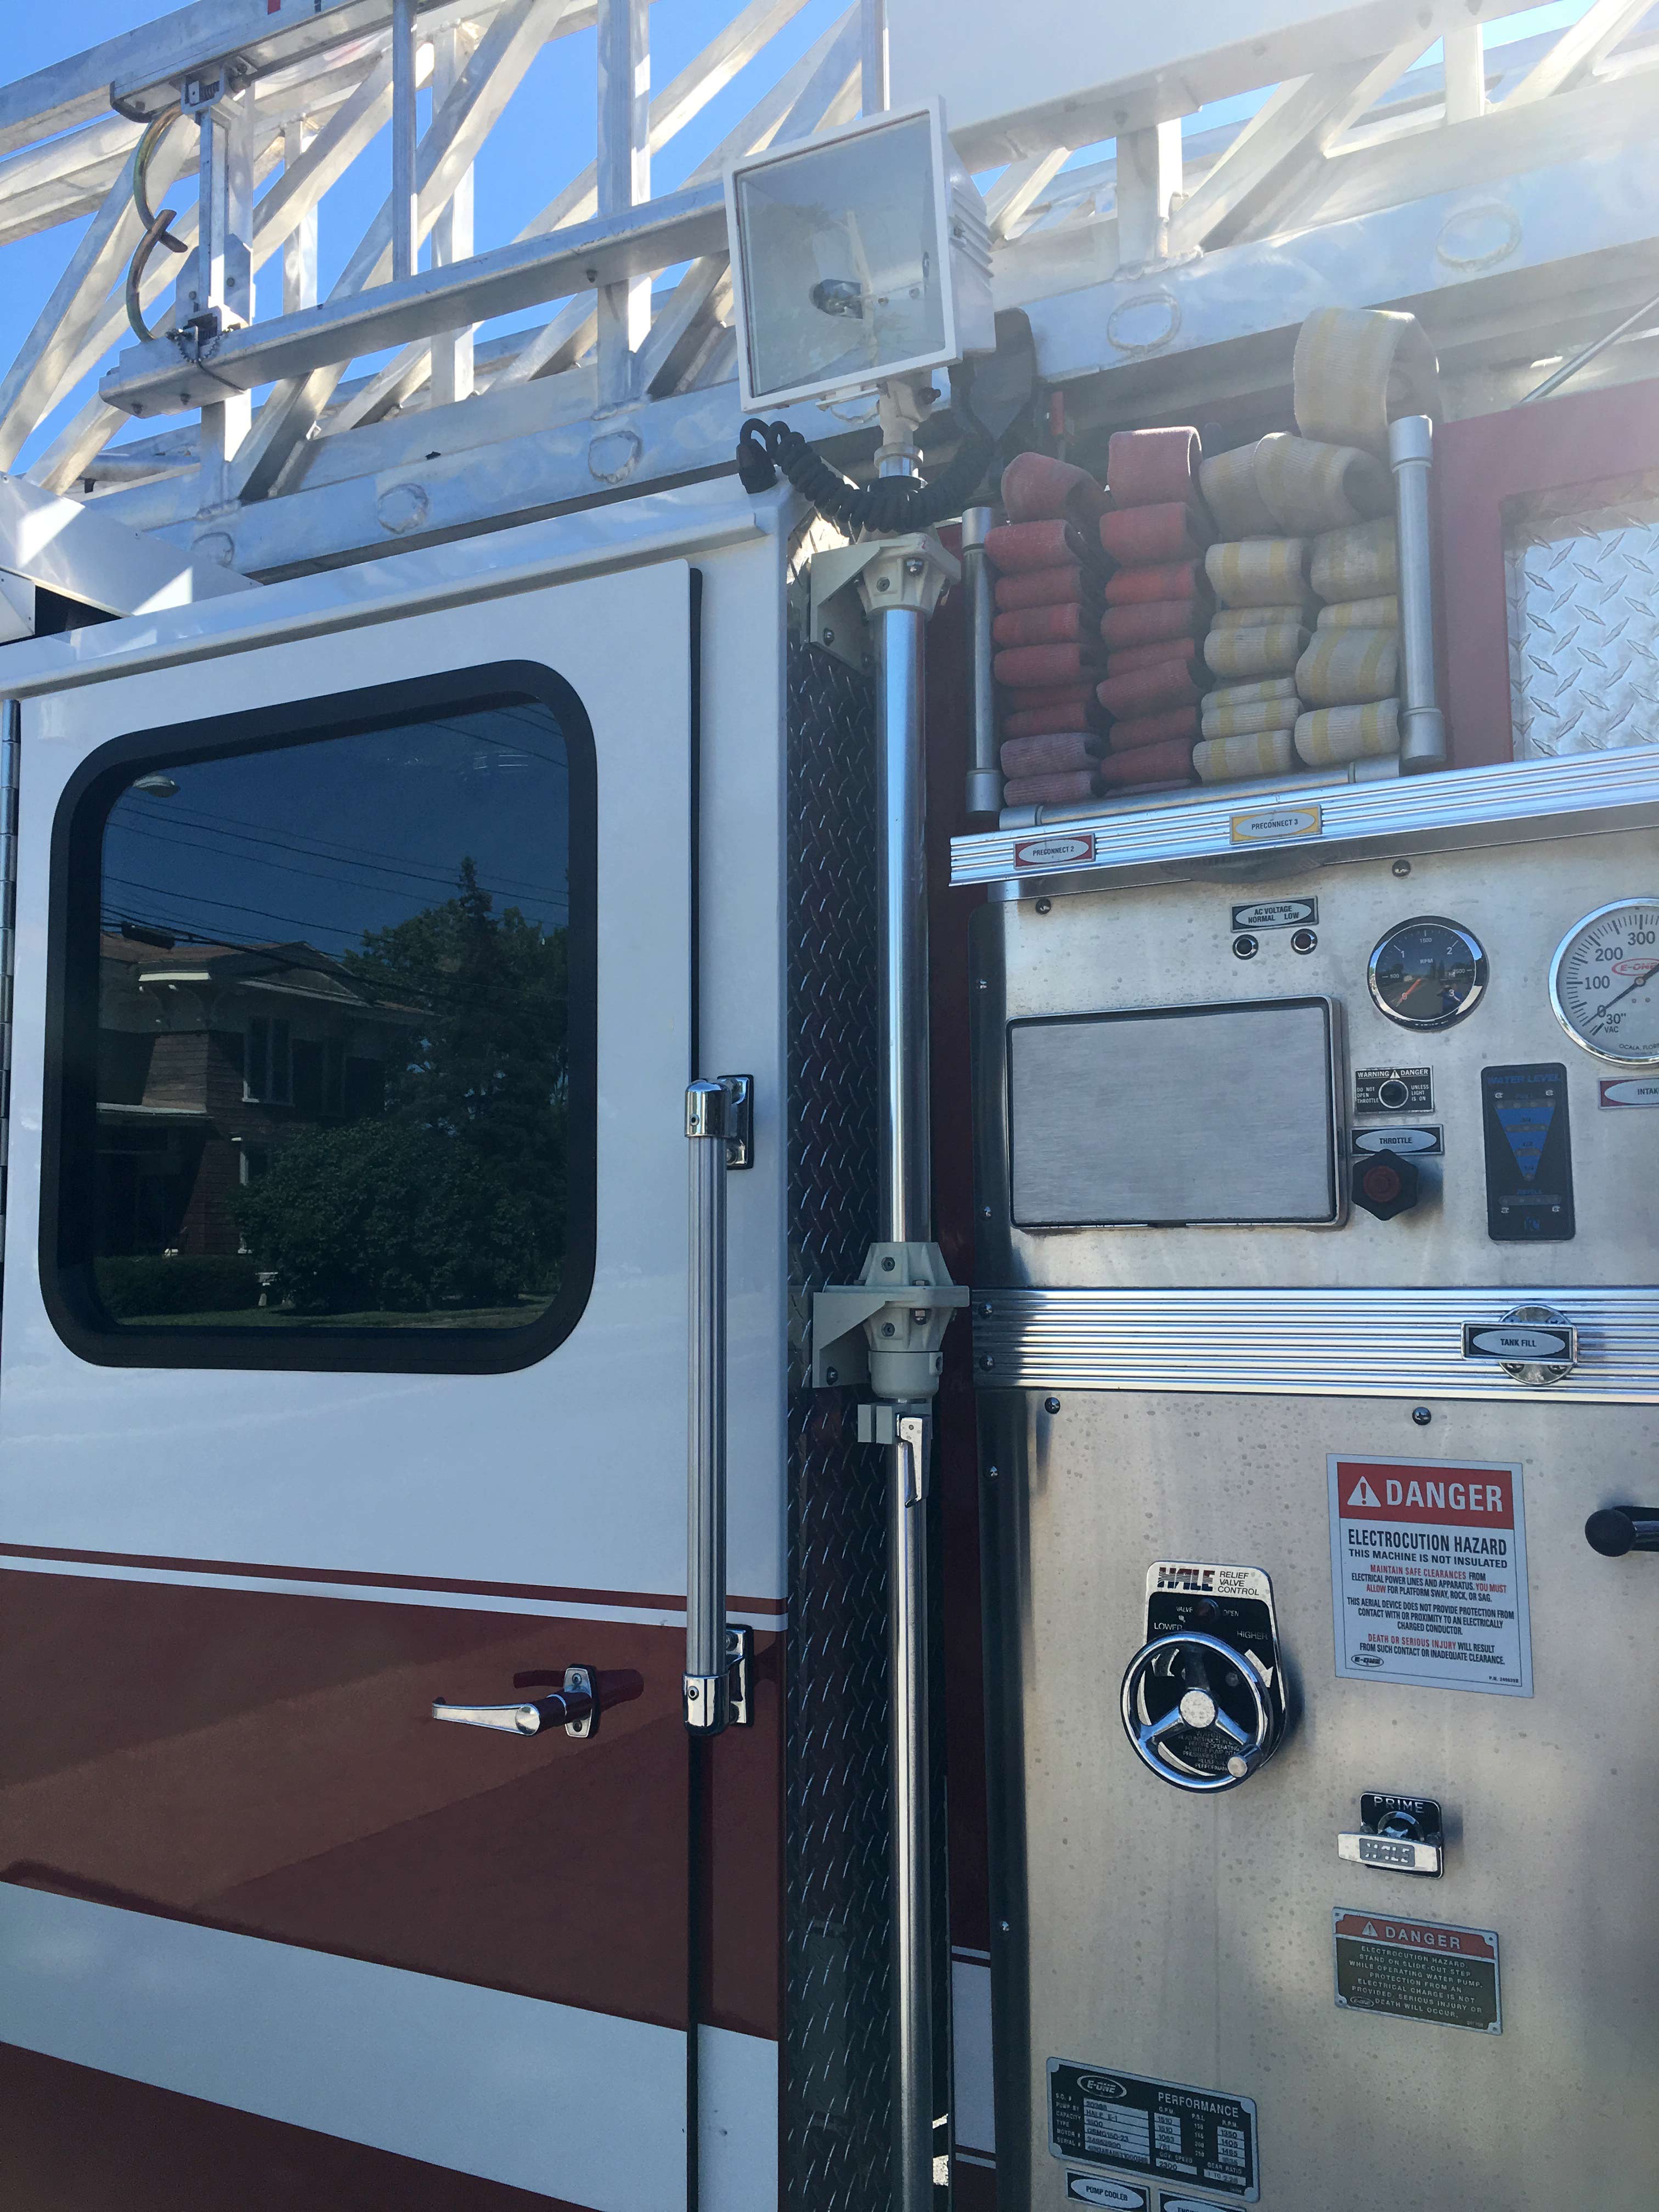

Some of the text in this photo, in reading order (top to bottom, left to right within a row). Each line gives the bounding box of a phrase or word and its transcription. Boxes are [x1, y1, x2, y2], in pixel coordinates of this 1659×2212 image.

[1252, 819, 1293, 830] PRECONNECT
[1033, 847, 1069, 856] PRECONNECT
[1264, 906, 1292, 914] VOLTAGE
[1248, 915, 1276, 923] NORMAL
[1627, 931, 1656, 946] 300
[1595, 947, 1623, 962] 200
[1585, 975, 1610, 990] 100
[1597, 1005, 1606, 1018] 0
[1386, 1479, 1503, 1512] DANGER
[1348, 1528, 1507, 1555] ELECTROCUTION HAZARD
[1348, 1549, 1508, 1568] THIS MACHINE IS NOT INSULATED
[1157, 1567, 1215, 1592] HALE
[1220, 1571, 1249, 1579] RELIEF
[1370, 1565, 1486, 1581] MAINTAIN SAFE CLEARANCES FROM
[1217, 1586, 1260, 1596] CONTROL
[1220, 1578, 1245, 1587] VALVE
[1352, 1572, 1507, 1593] ELECTRICAL POWER LINES AND APPARATUS. YOU MUST
[1366, 1584, 1492, 1602] ALLOW FOR PLATFORM SWAY, ROCK, OR SAG.
[1347, 1597, 1515, 1620] THIS AERIAL DEVICE DOES NOT PROVIDE PROTECTION FROM
[1154, 1622, 1183, 1631] LOWER
[1358, 1607, 1503, 1629] CONTACT WITH OR PROXIMITY TO AN ELECTRICALLY
[1237, 1630, 1268, 1640] HIGHER
[1397, 1622, 1463, 1635] CHARGED CONDUCTOR.
[1368, 1633, 1495, 1654] DEATH OR SERIOUS INJURY WILL RESULT
[1360, 1643, 1505, 1665] FROM SUCH CONTACT OR INADEQUATE CLEARANCE.
[1374, 1796, 1424, 1813] PRIME
[1385, 1926, 1460, 1949] DANGER
[1361, 1945, 1468, 1968] ELECTROCUTION HAZARD.
[1349, 1960, 1483, 1988] WHILE OPERATING WATER PUMP.
[1359, 1954, 1385, 1963] STAND
[1403, 1961, 1446, 1973] SLIDE-OUT
[1450, 1969, 1470, 1977] STEP
[1358, 1978, 1407, 1992] ELECTRICAL
[1410, 1988, 1444, 1997] CHARGE
[1369, 1972, 1421, 1985] PROTECTION
[1425, 1982, 1447, 1990] FROM
[1375, 1998, 1459, 2018] DEATH WILL OCCUR.
[1398, 1994, 1434, 2005] SERIOUS
[1437, 2001, 1467, 2011] INJURY
[1087, 2080, 1116, 2094] E-ONE
[1158, 2091, 1239, 2118] PERFORMANCE
[1056, 2111, 1081, 2120] CAPACITY
[1057, 2137, 1076, 2146] SERIAL
[1158, 2125, 1238, 2148] 1510 1405
[1221, 2130, 1238, 2138] 1350
[1207, 2162, 1223, 2171] GEAR
[1086, 2185, 1128, 2202] PUMP COOLER
